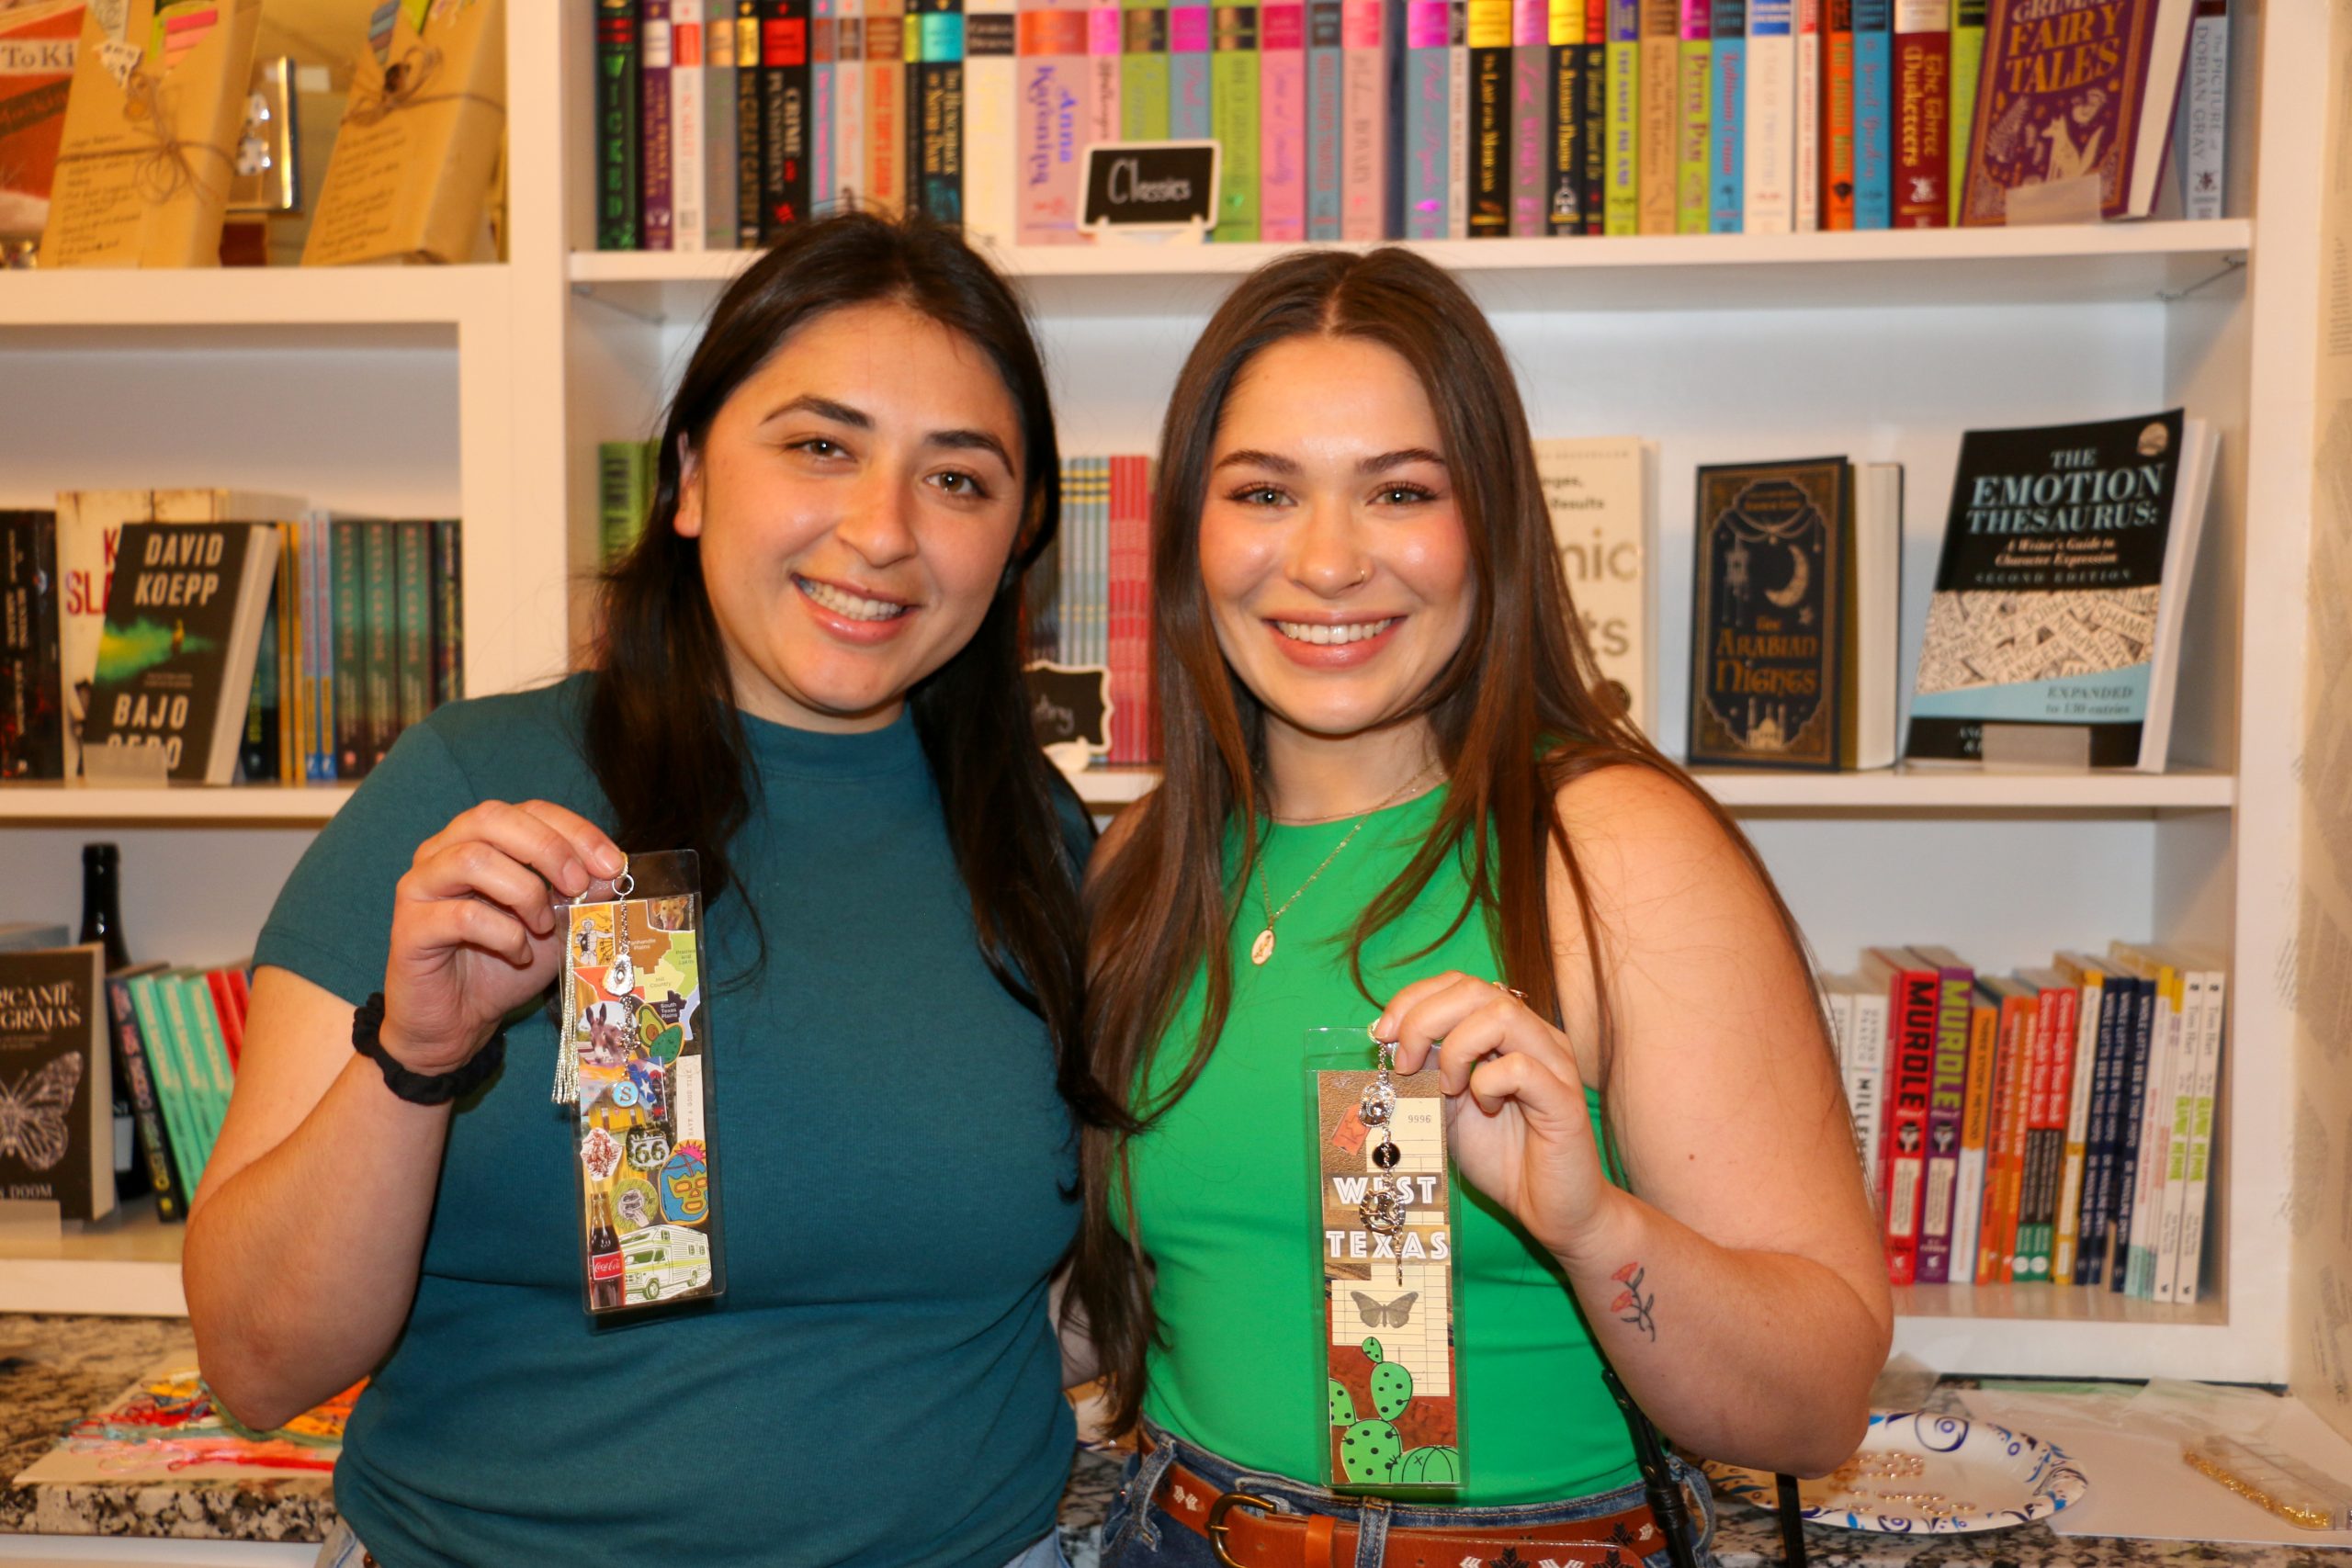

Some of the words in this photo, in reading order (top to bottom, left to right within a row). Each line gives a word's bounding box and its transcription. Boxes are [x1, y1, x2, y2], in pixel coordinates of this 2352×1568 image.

[2009, 3, 2124, 56] FAIRY
[1924, 53, 1944, 95] The
[2006, 39, 2119, 93] TALES
[2193, 26, 2210, 101] DORIAN
[1903, 45, 1923, 167] Musketeers
[2210, 58, 2223, 134] PICTURE
[785, 87, 801, 157] CRIME
[1028, 66, 1058, 187] Karenina
[1059, 90, 1080, 163] Anna
[1924, 98, 1944, 156] Three
[2192, 108, 2209, 161] GRAY
[1106, 158, 1192, 205] Classics
[2051, 447, 2098, 469] THE
[1550, 497, 1605, 509] Results
[1972, 464, 2166, 510] EMOTION
[1967, 501, 2159, 535] THESAURUS:
[144, 532, 224, 568] DAVID
[1995, 553, 2052, 568] Character
[2053, 552, 2119, 569] Expression
[2018, 537, 2064, 552] Writer's
[2066, 536, 2102, 551] Guide
[2103, 537, 2116, 549] to
[134, 571, 220, 607] KOEPP
[1975, 571, 2045, 584] SECOND
[2053, 568, 2132, 583] EDITION
[2046, 685, 2135, 699] EXPANDED
[2046, 702, 2059, 715] to
[2087, 703, 2132, 715] entries
[112, 693, 189, 730] BAJO
[630, 938, 656, 946] anhandle
[2186, 1005, 2199, 1029] Tom
[2205, 1006, 2219, 1029] Tom
[1899, 980, 1936, 1110] MURDLE
[1930, 979, 1972, 1110] MURDLE
[2184, 1032, 2197, 1055] Hart
[2204, 1032, 2217, 1055] Hart
[1975, 1054, 1987, 1089] STORY
[619, 1087, 632, 1102] S
[2029, 1092, 2044, 1123] Book
[2048, 1092, 2064, 1123] Book
[1408, 1114, 1431, 1124] 9996
[1972, 1093, 1984, 1140] METHOD
[635, 1140, 666, 1164] 66
[11, 1184, 52, 1199] DOOM
[1326, 1230, 1449, 1260] TEXAS
